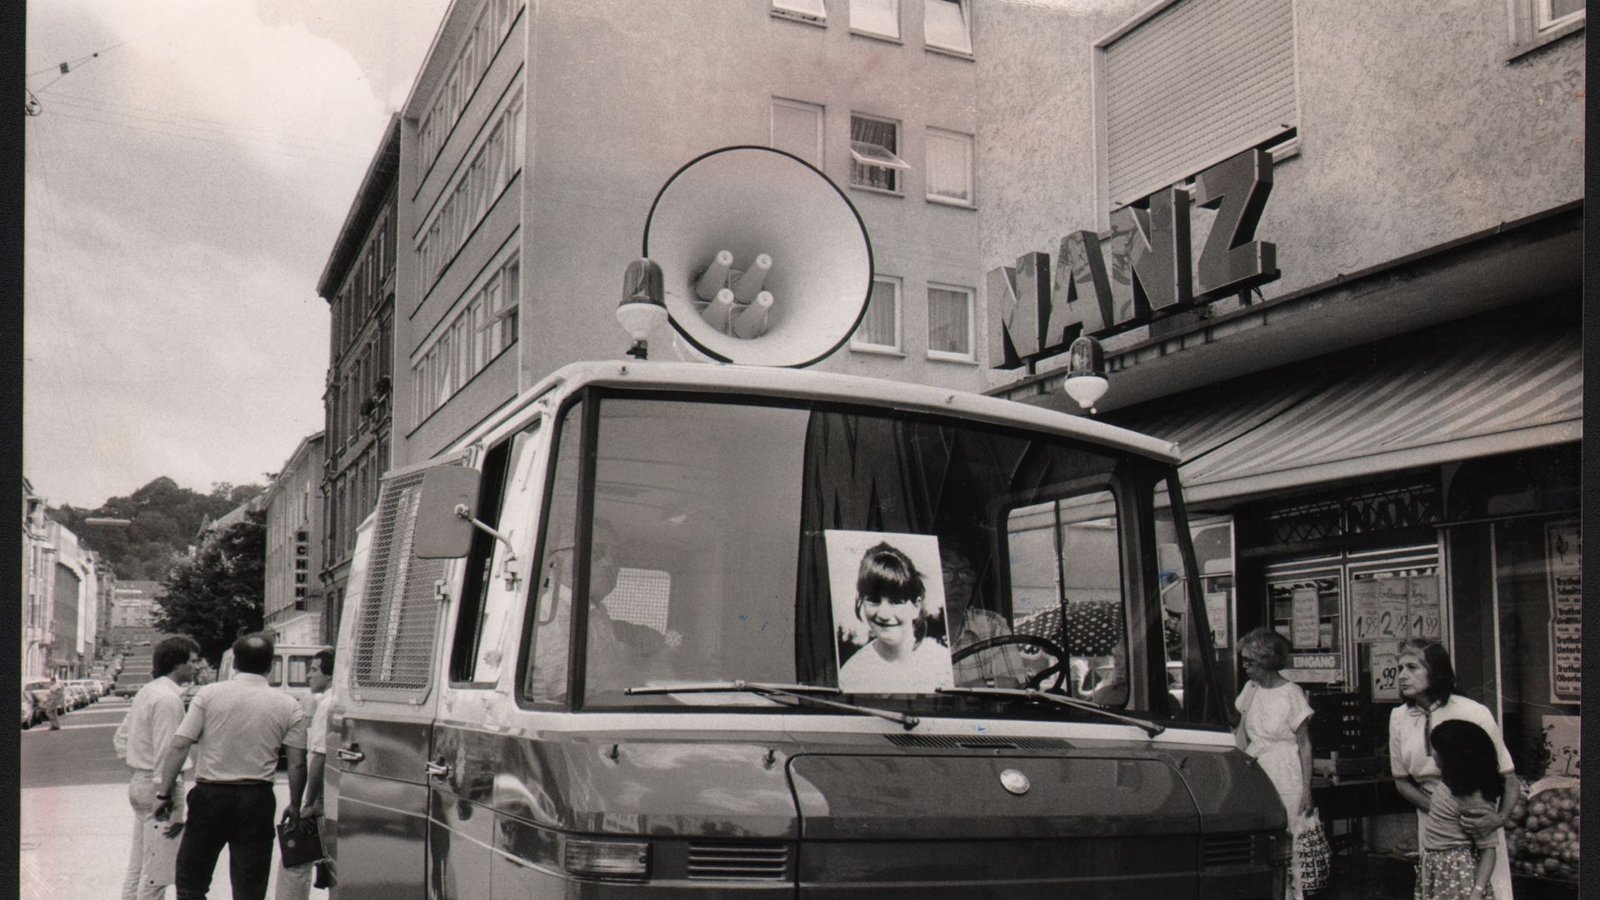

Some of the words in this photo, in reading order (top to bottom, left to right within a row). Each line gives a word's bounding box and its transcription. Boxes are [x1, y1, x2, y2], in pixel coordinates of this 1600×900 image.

[987, 149, 1276, 370] NANZ
[296, 531, 306, 611] SCHUHE
[1293, 656, 1335, 669] EINGANG
